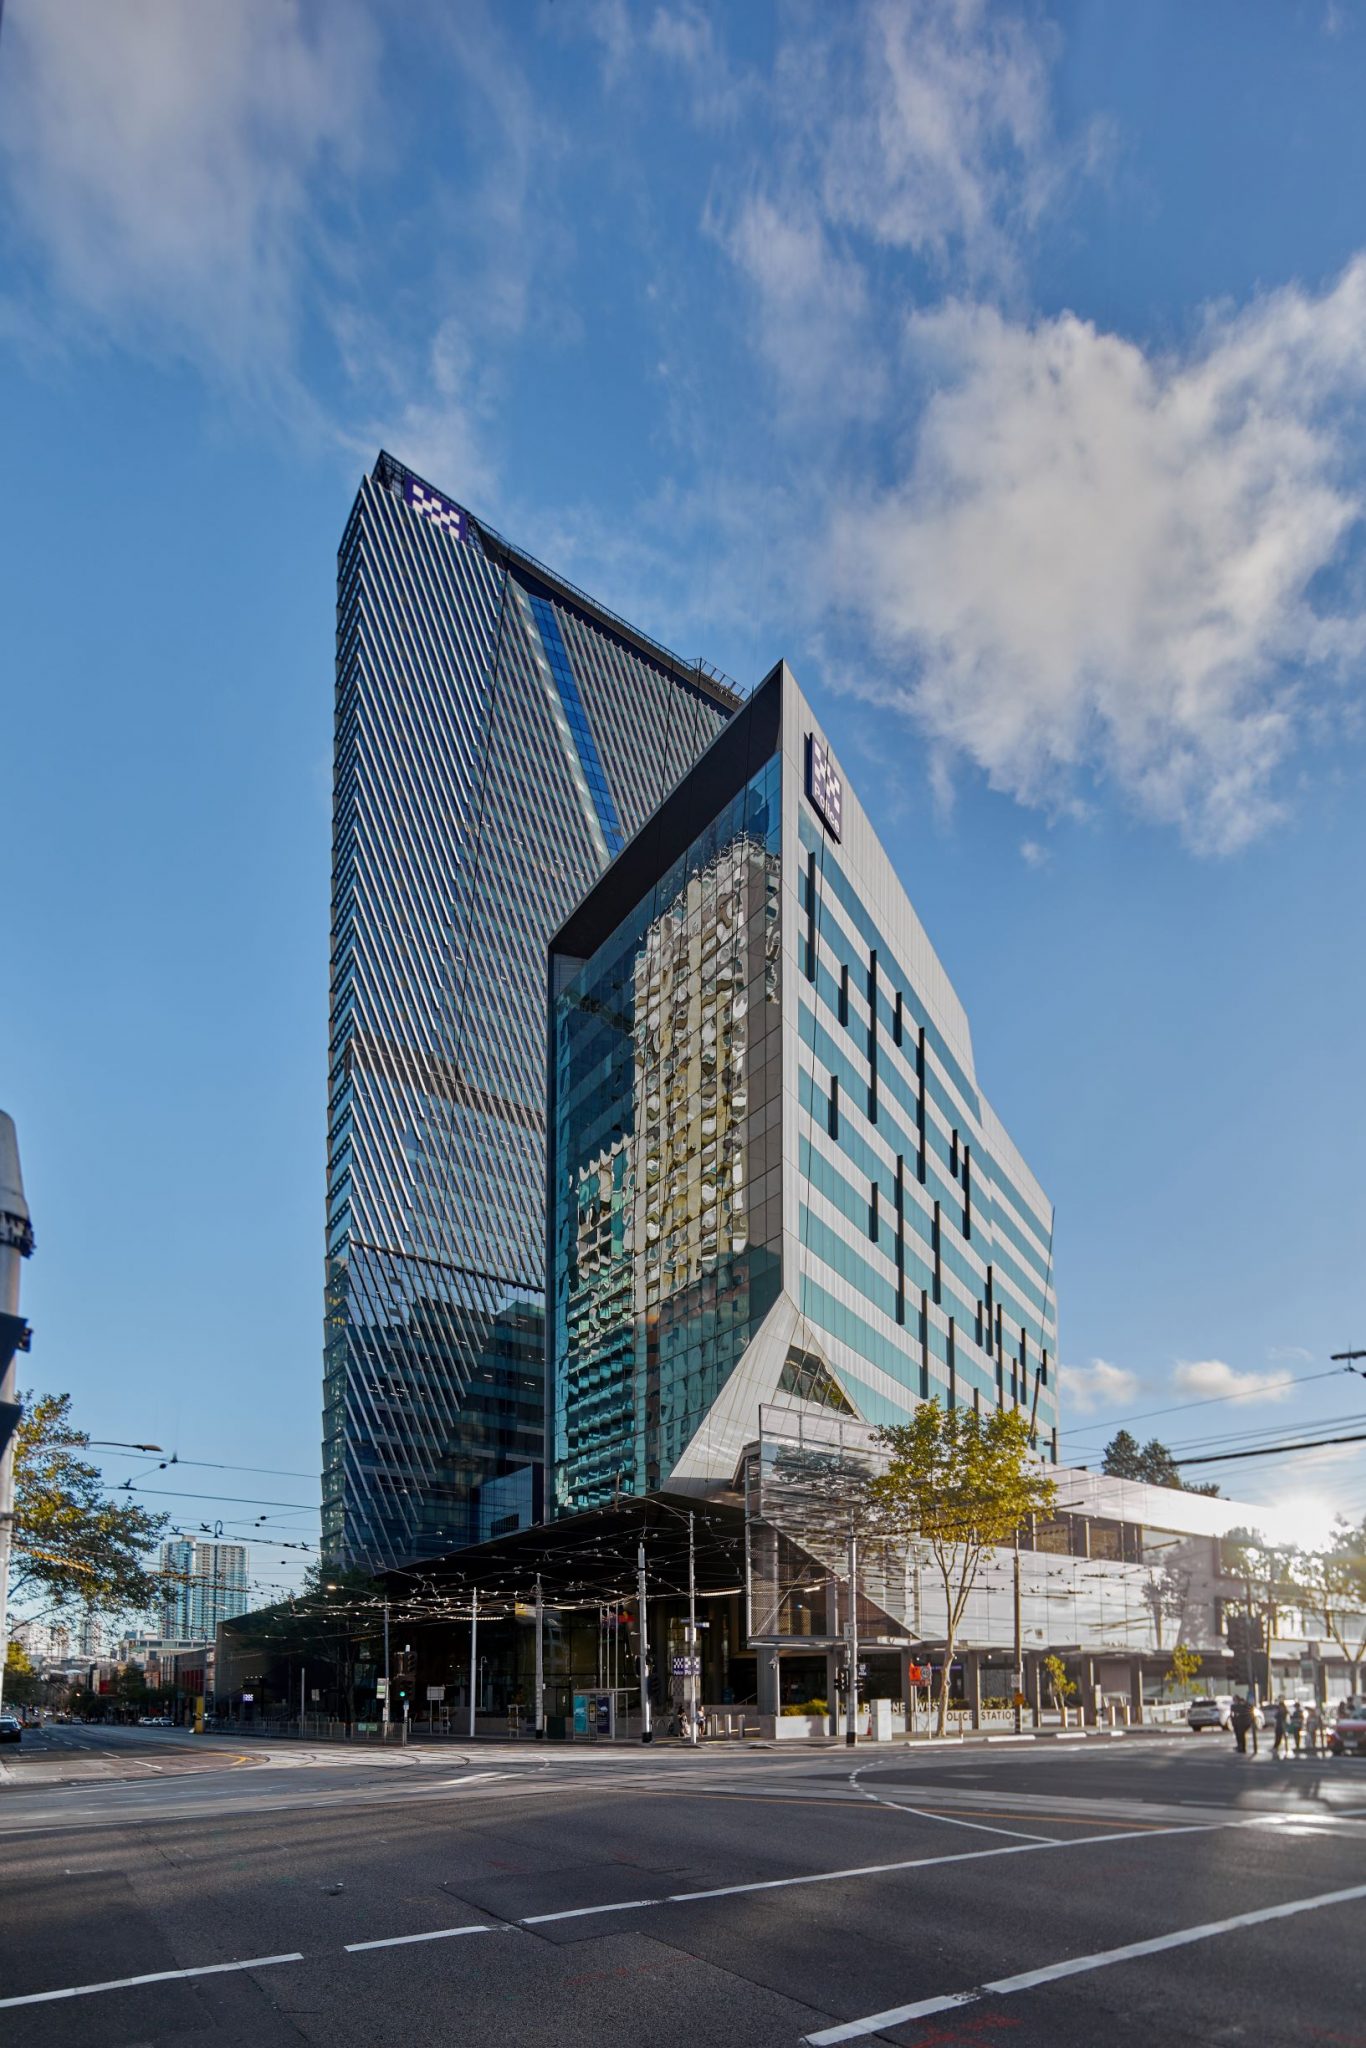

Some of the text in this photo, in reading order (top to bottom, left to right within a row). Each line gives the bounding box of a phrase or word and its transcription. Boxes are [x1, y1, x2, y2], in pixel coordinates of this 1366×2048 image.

[814, 780, 840, 833] Police
[915, 1702, 940, 1712] WES
[946, 1711, 973, 1721] OLICE
